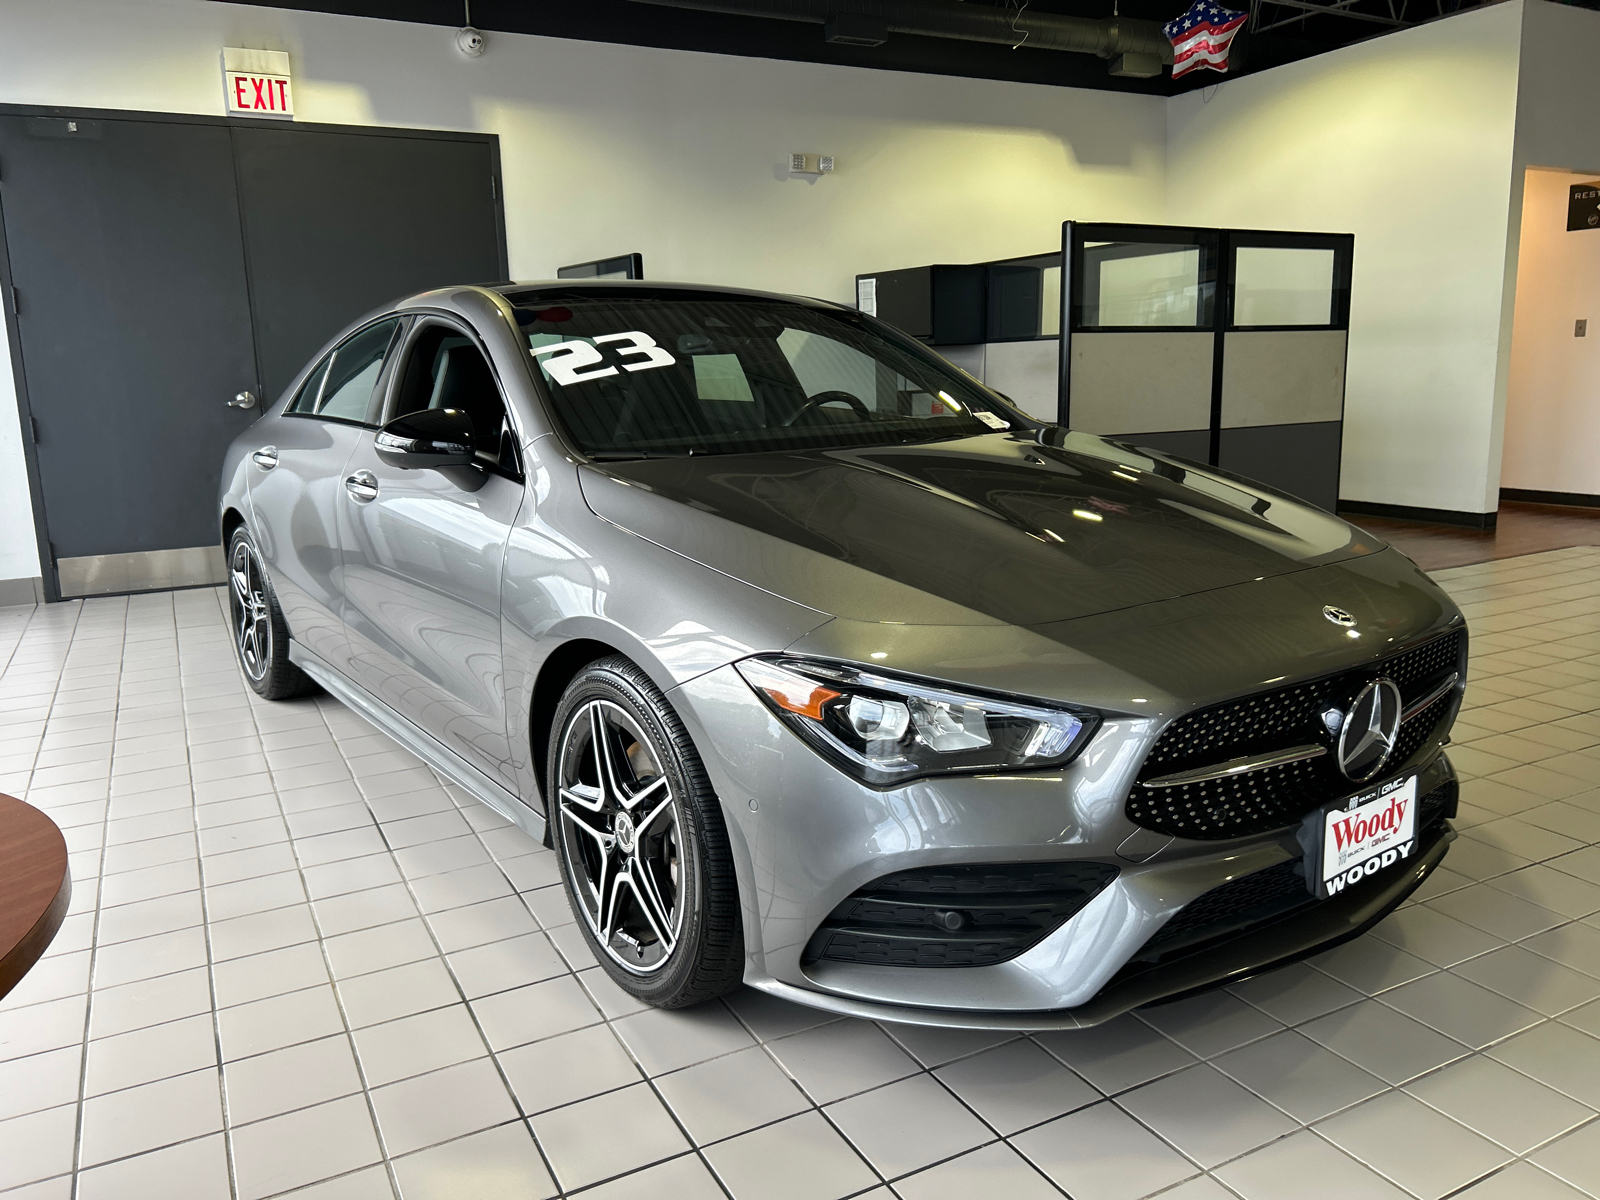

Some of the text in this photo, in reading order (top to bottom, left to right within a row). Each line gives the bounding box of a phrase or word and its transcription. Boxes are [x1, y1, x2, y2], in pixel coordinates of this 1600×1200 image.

[235, 76, 288, 112] EXIT
[529, 331, 676, 387] 23
[1358, 777, 1404, 803] BUICK GMC
[1332, 797, 1409, 853] Woody
[1347, 833, 1391, 858] BUICK GMC
[1326, 840, 1413, 896] WOODY
